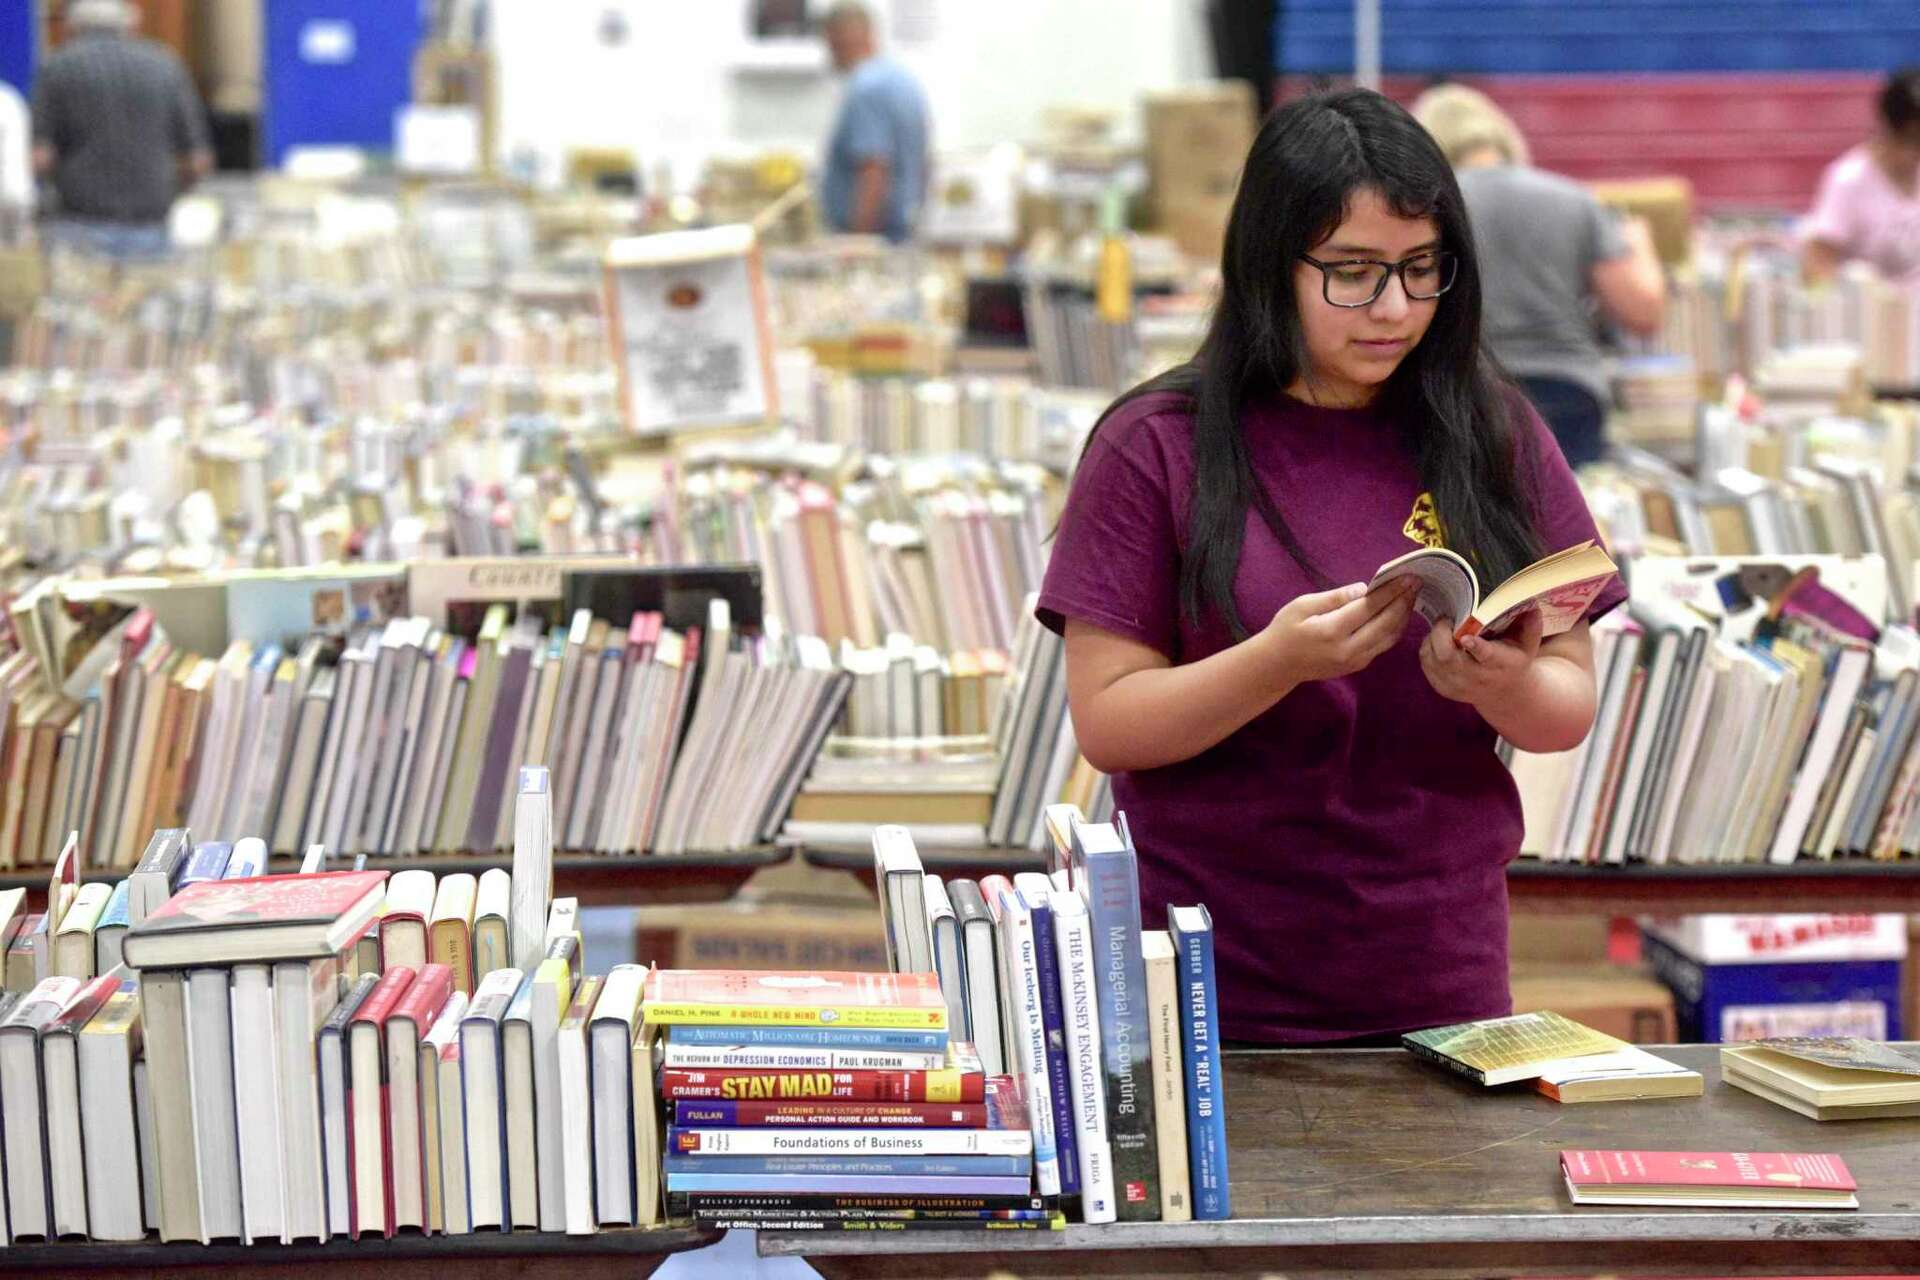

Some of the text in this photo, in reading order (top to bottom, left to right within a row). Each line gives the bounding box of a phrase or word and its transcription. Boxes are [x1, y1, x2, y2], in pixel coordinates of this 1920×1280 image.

[1190, 938, 1201, 974] GERBER
[1109, 926, 1131, 1016] Managerial
[1192, 982, 1205, 1017] NEVER
[653, 1008, 685, 1017] DANIEL
[1021, 940, 1044, 1074] Our Iceberg Is Melting
[740, 1011, 768, 1019] WHOLE
[773, 1011, 790, 1019] NEW
[795, 1012, 816, 1020] MIND
[1068, 928, 1098, 1132] THE McKINSEY ENGAGEMENT
[1193, 1022, 1208, 1041] GET
[1195, 1045, 1208, 1053] A
[686, 1055, 711, 1063] RETURN
[723, 1055, 774, 1065] DEPRESSION
[778, 1055, 826, 1066] ECONOMICS
[839, 1056, 902, 1067] PAUL KRUGMAN
[1115, 1022, 1138, 1115] Accounting
[687, 1074, 705, 1083] JIM
[834, 1074, 852, 1083] FOR
[1055, 1060, 1067, 1105] MATTHEW
[672, 1087, 720, 1096] CRAMER'S
[721, 1073, 833, 1099] STAY MAD
[833, 1087, 852, 1096] LIFE
[878, 1107, 912, 1115] CHANGE
[1198, 1097, 1212, 1117] JOB
[687, 1111, 723, 1120] FULLAN
[1060, 1111, 1069, 1138] KELLY
[773, 1137, 923, 1148] Foundations of Business
[1090, 1153, 1100, 1184] FRIGA
[733, 1221, 760, 1229] Office,
[762, 1221, 791, 1229] Second
[793, 1221, 824, 1229] Edition
[843, 1221, 867, 1229] Smith
